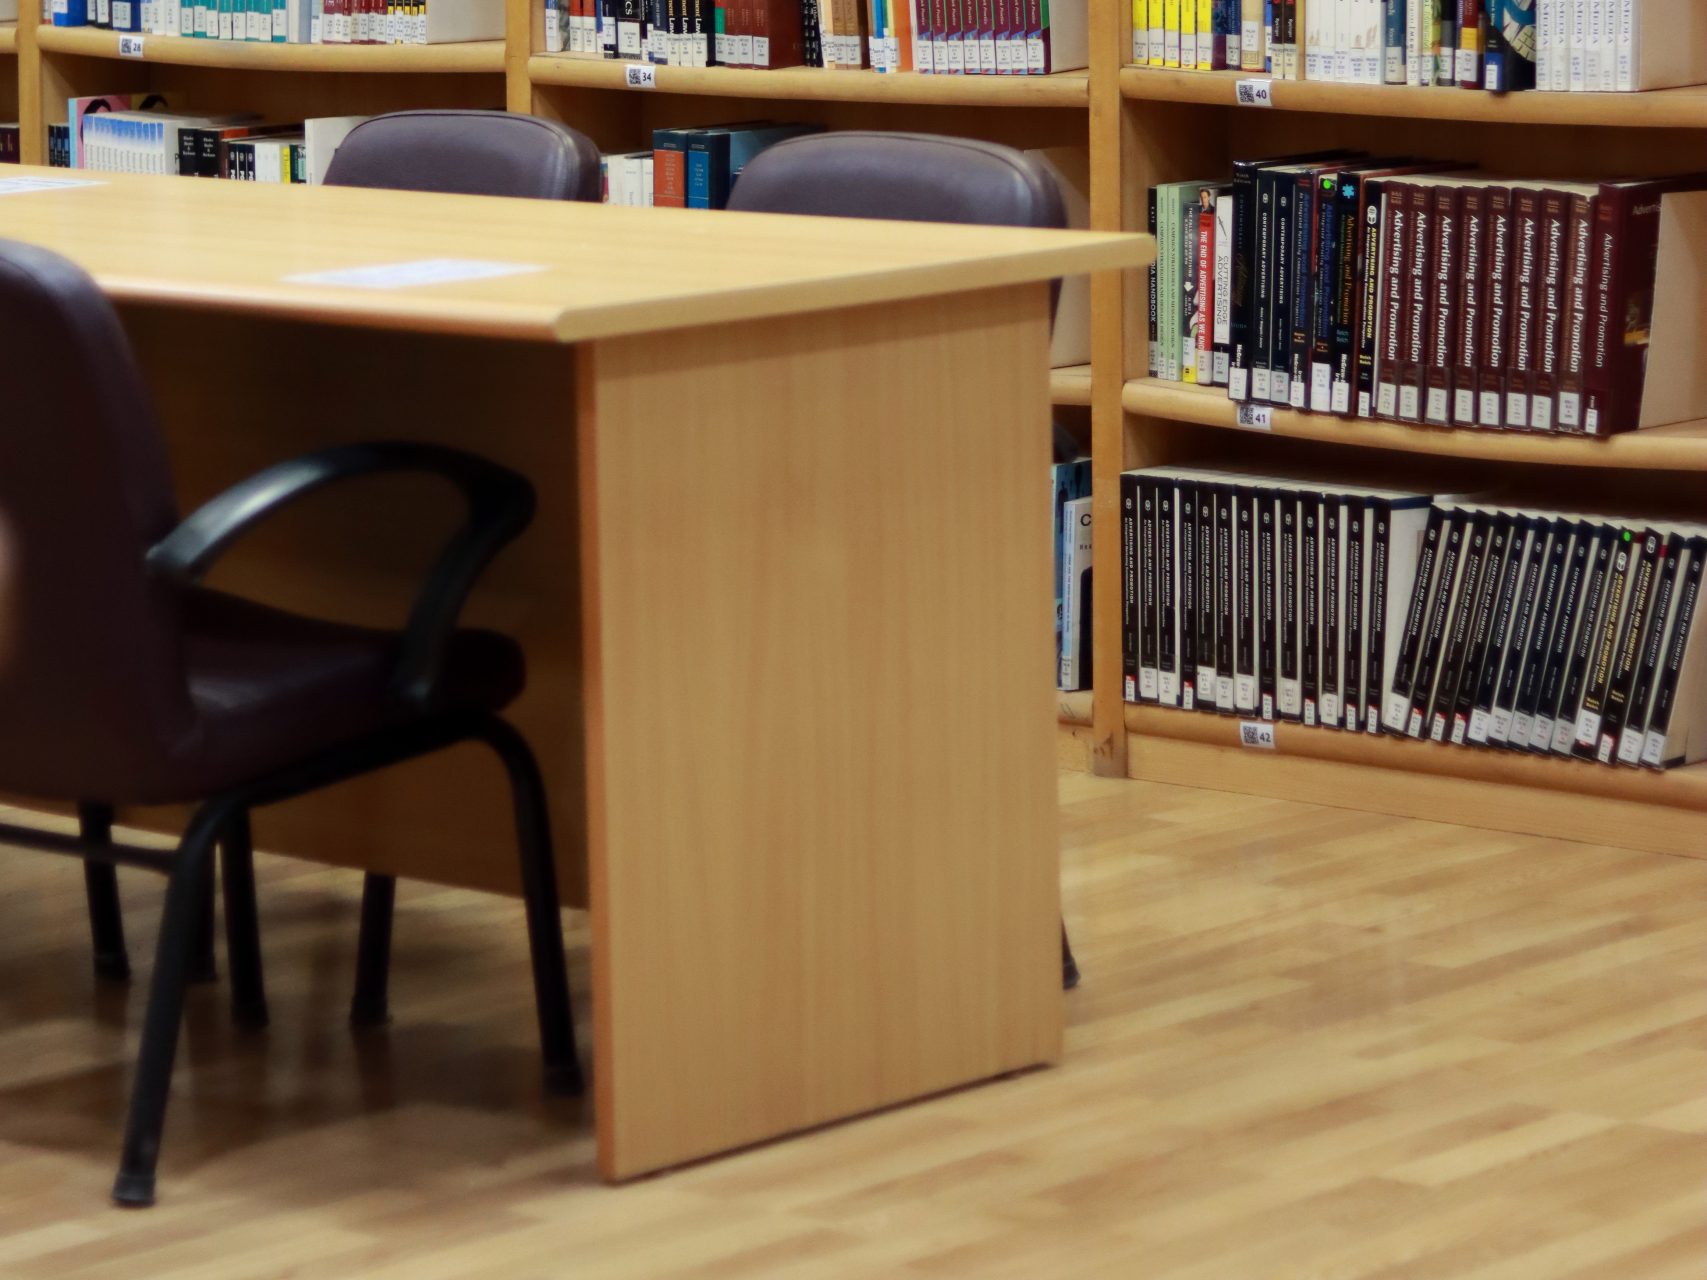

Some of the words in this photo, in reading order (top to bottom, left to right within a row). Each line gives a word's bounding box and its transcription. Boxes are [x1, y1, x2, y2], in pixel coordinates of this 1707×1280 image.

[133, 42, 141, 52] 28
[642, 72, 651, 82] 34
[1255, 90, 1267, 99] 40
[1200, 244, 1208, 258] END
[1390, 210, 1404, 274] Advertising
[1573, 219, 1589, 285] Advertising
[1201, 260, 1208, 268] OF
[1599, 233, 1614, 291] Advertising
[1391, 277, 1400, 298] and
[1574, 287, 1585, 310] and
[1600, 292, 1608, 313] and
[1199, 314, 1206, 322] AS
[1199, 324, 1206, 334] WE
[1388, 299, 1399, 360] Promotion
[1570, 312, 1584, 373] Promotion
[1596, 314, 1608, 368] Promotion
[1255, 414, 1266, 424] 41
[1610, 574, 1624, 628] ADVERTISING
[1597, 643, 1612, 684] PROMOTION
[1259, 732, 1271, 743] 42
